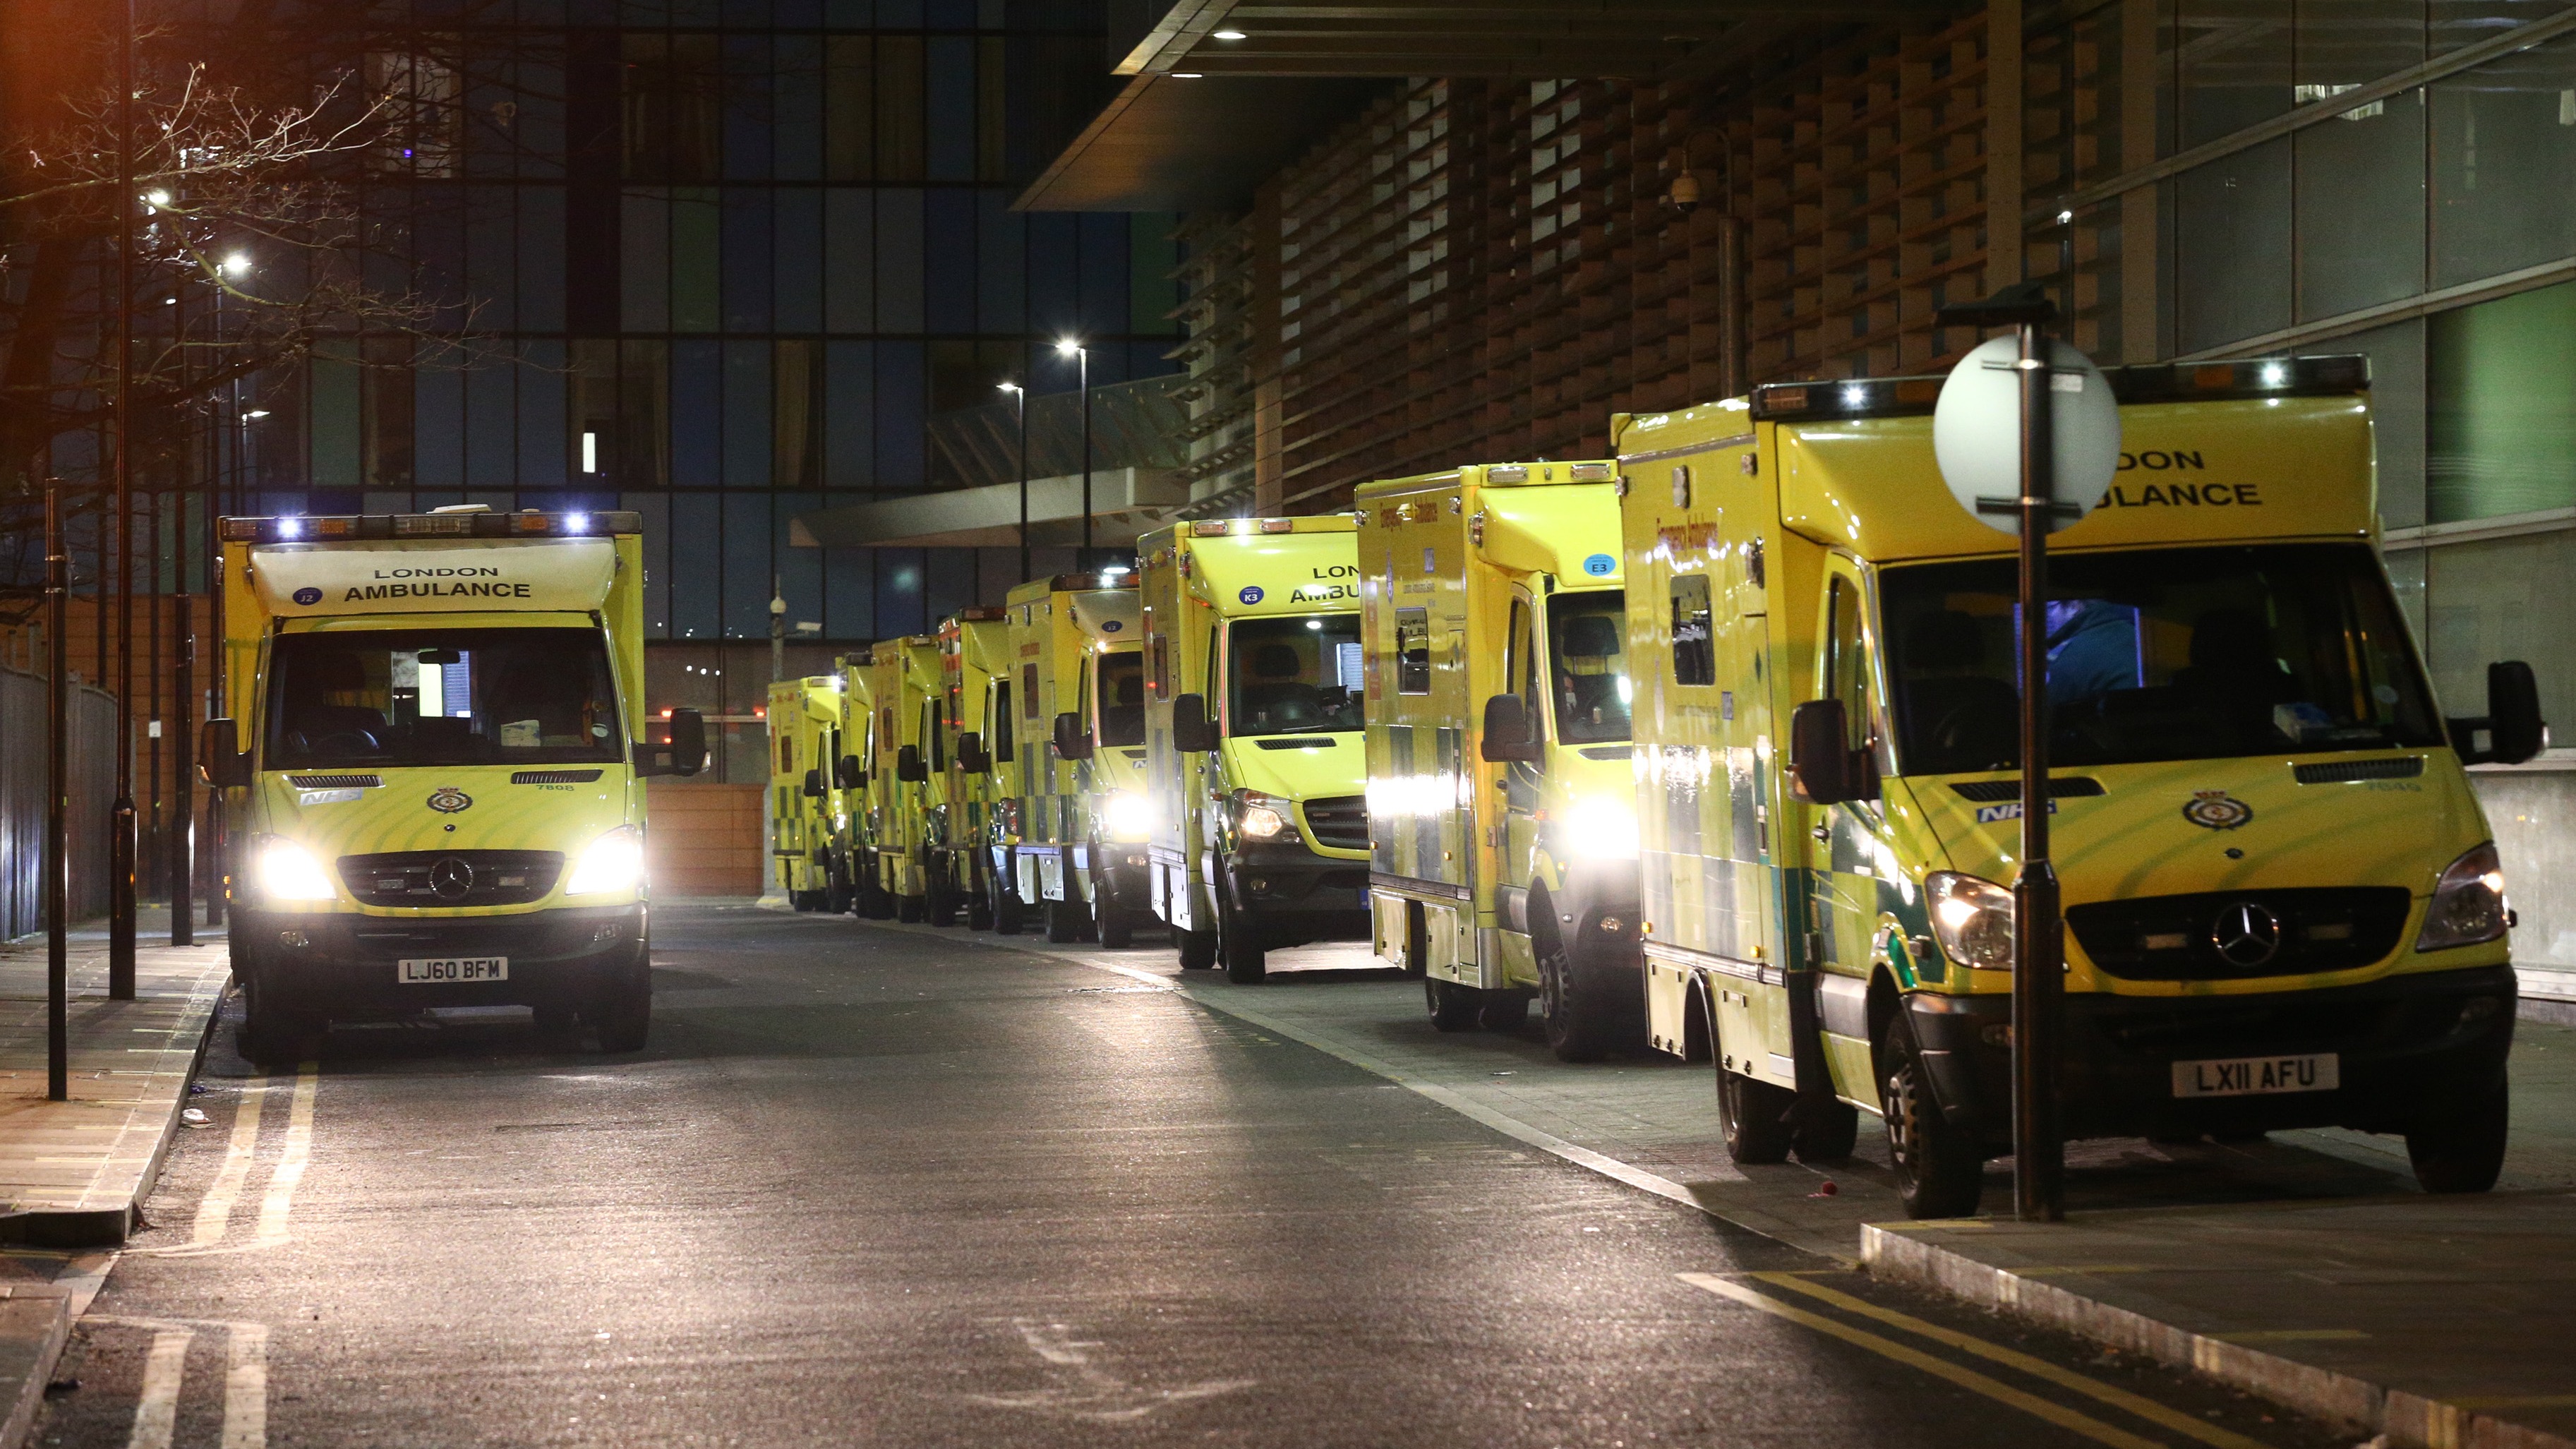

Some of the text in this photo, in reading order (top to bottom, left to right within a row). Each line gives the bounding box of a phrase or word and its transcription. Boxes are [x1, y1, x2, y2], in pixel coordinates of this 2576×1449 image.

[375, 567, 498, 579] LONDON
[1591, 564, 1607, 572] E3
[344, 582, 531, 602] AMBULANCE
[1244, 594, 1258, 602] K3
[407, 960, 500, 980] LJ60 BFM
[2196, 1059, 2315, 1092] LX11 AFU
